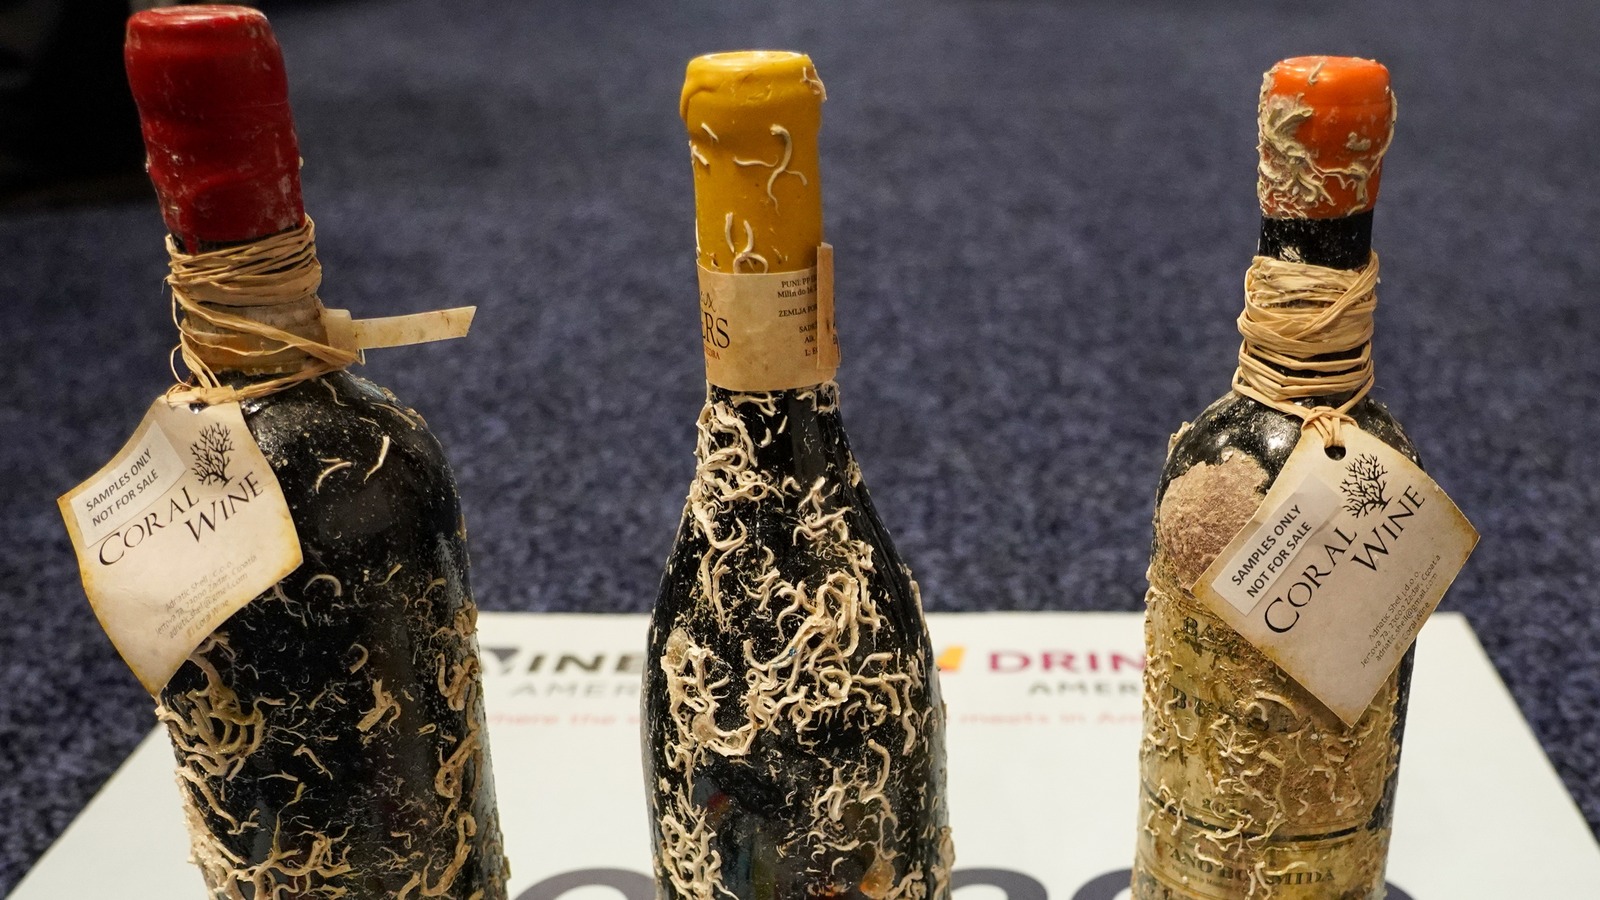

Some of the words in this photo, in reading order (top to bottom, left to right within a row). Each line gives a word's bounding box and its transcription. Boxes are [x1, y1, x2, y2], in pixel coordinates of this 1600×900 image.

[701, 311, 730, 348] RS
[86, 472, 131, 512] SAMPLES
[130, 448, 152, 476] ONLY
[92, 505, 114, 527] NOT
[115, 489, 137, 510] FOR
[136, 469, 159, 494] SALE
[184, 471, 264, 543] WINE
[98, 486, 200, 566] CORAL
[1231, 536, 1277, 586] SAMPLES
[1275, 504, 1301, 537] ONLY
[1246, 572, 1271, 598] NOT
[1268, 550, 1290, 574] FOR
[1286, 521, 1312, 551] SALE
[1350, 485, 1425, 573] WINE
[1264, 527, 1358, 634] CORAL
